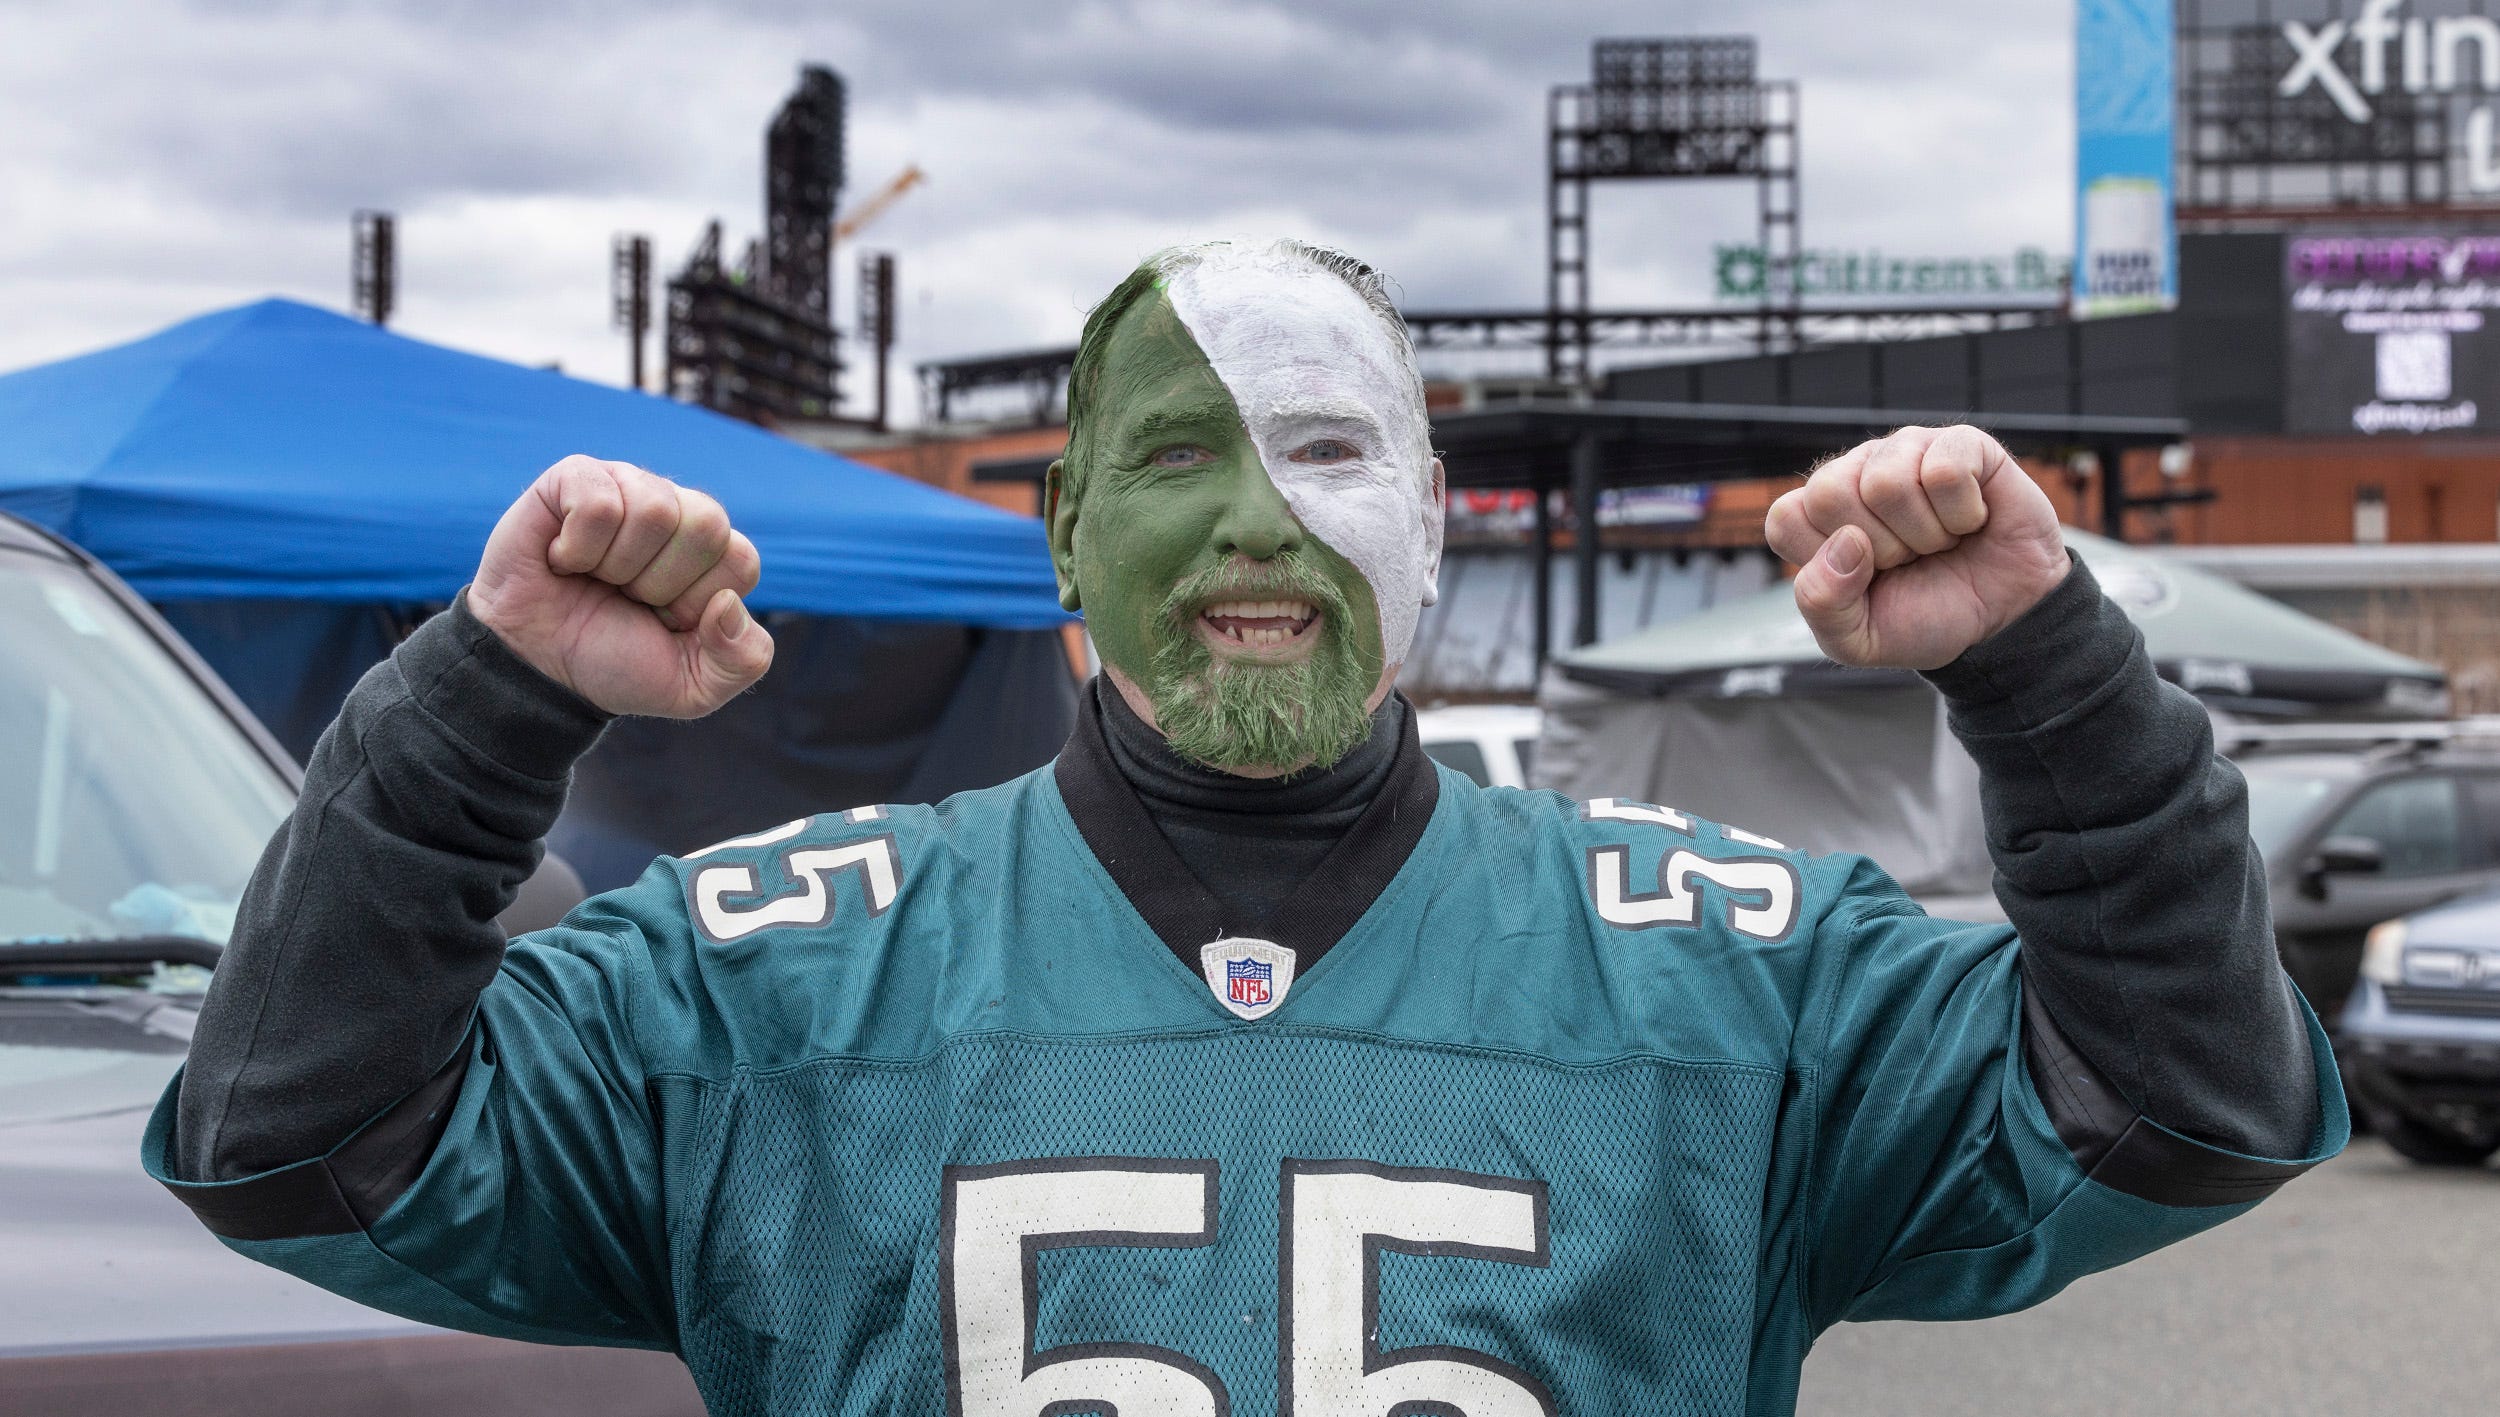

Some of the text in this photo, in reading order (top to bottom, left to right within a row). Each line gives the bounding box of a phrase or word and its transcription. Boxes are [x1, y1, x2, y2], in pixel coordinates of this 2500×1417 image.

[1794, 246, 2003, 294] Citizens
[1231, 978, 1269, 1005] NFL
[939, 1155, 1558, 1417] 55
